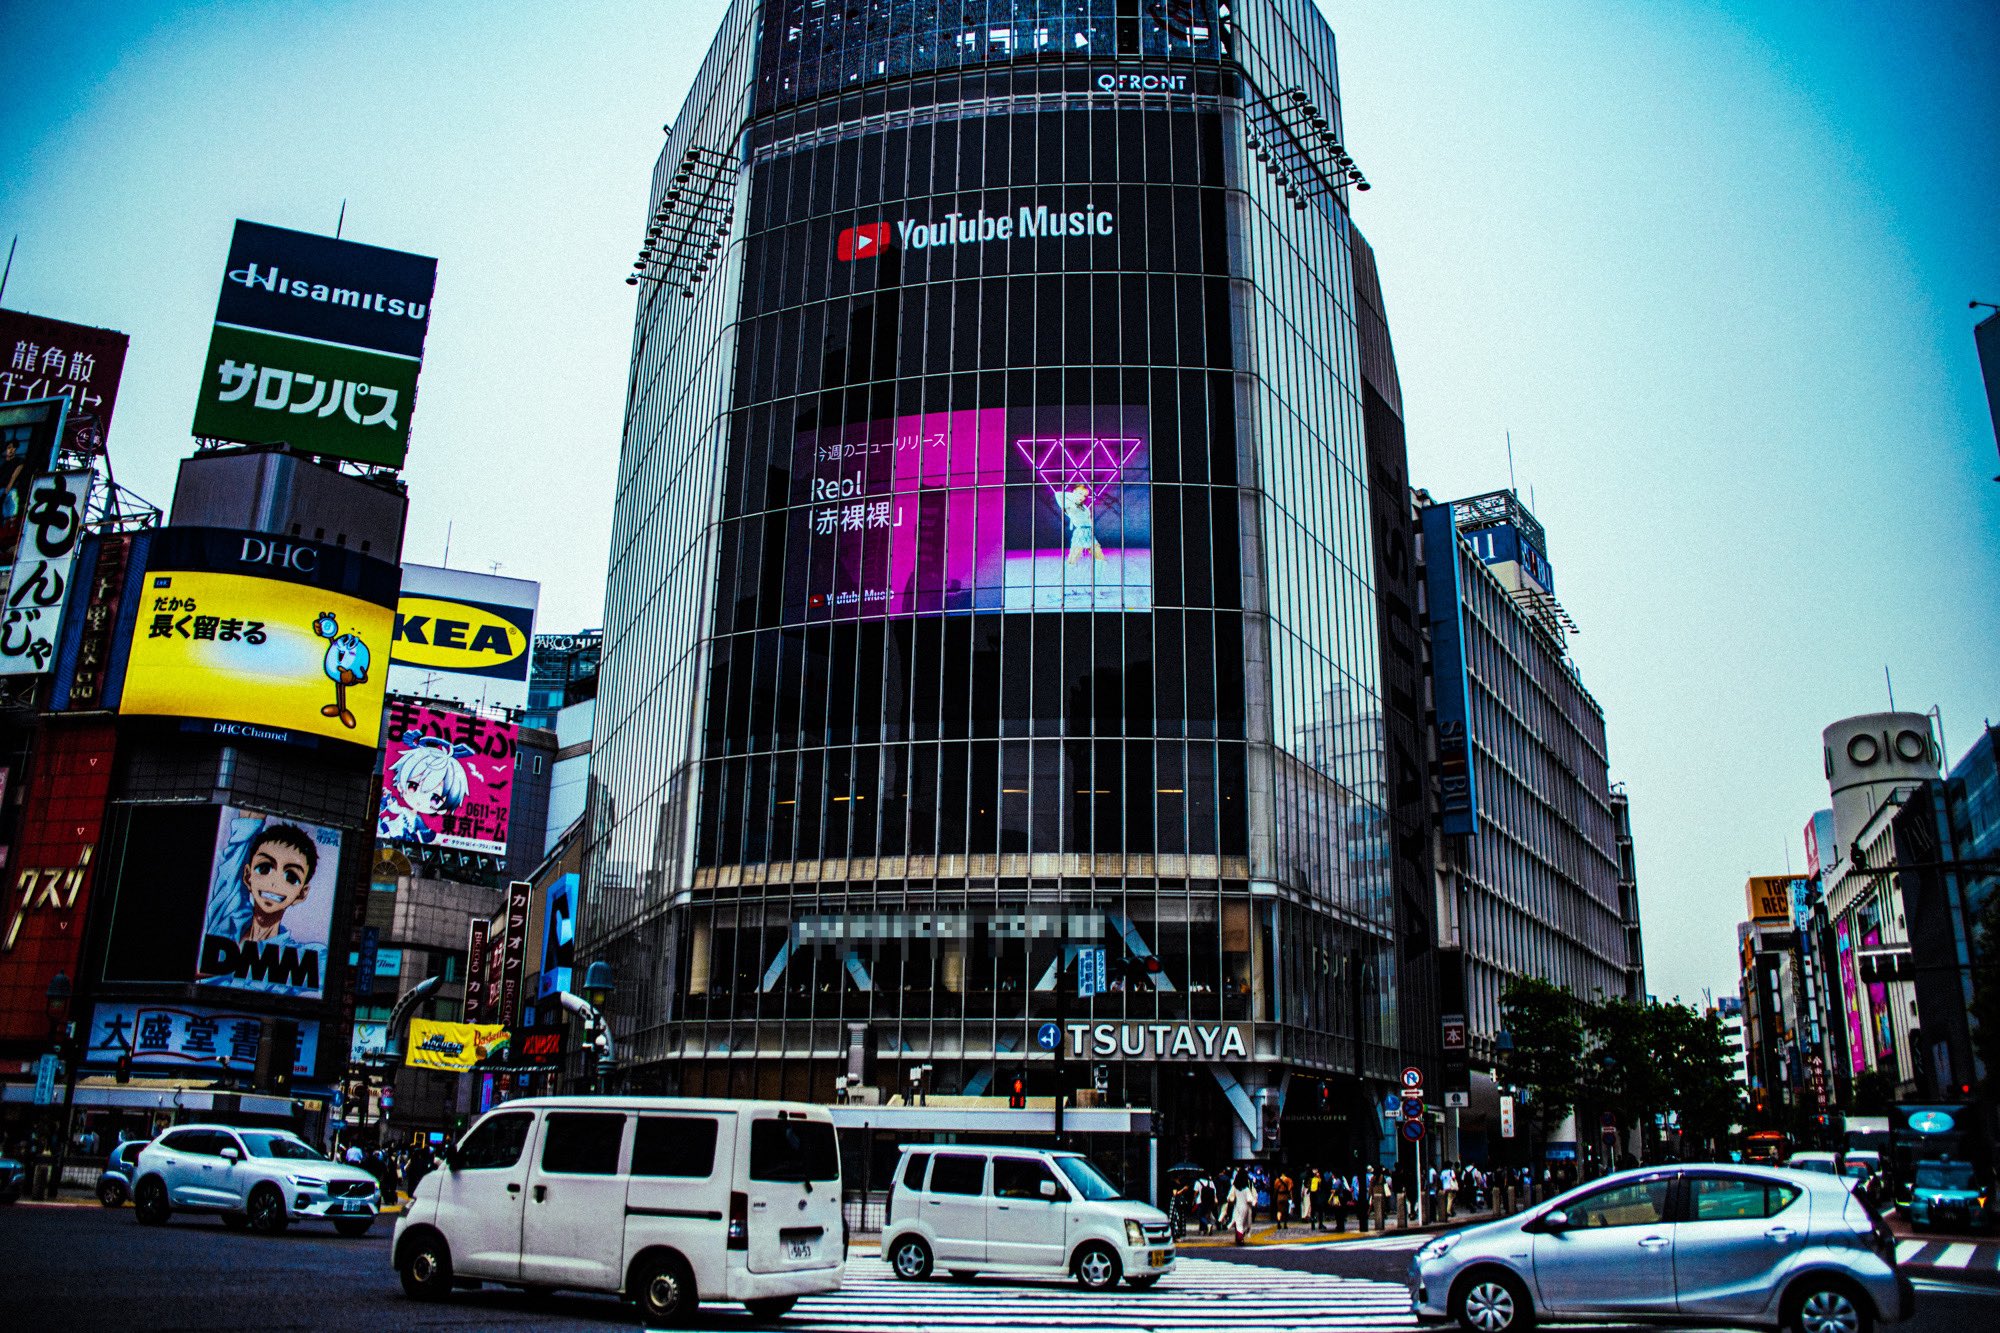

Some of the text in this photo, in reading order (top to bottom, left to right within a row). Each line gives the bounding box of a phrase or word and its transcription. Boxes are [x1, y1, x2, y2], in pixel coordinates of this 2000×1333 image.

[1098, 74, 1187, 93] QFRONT
[897, 203, 1113, 250] YouTube Music
[228, 263, 426, 320] Hisamitsu
[11, 341, 96, 383] 龍角散
[218, 359, 399, 431] サロンパス
[814, 433, 946, 462] 今週のニューリリース
[811, 470, 862, 501] Reol
[808, 502, 903, 535] 「赤裸裸」
[0, 475, 80, 669] もんじゃ
[240, 538, 317, 571] DHC
[153, 597, 196, 612] だから
[149, 615, 266, 645] 長く留まる
[395, 613, 513, 655] KEA
[213, 722, 287, 743] DHC Channel
[388, 701, 517, 760] まふまふ
[442, 815, 505, 843] 東京ドーム
[466, 802, 507, 821] 0611-12
[4, 844, 95, 951] クスリ
[506, 893, 527, 970] カラオケ
[200, 933, 320, 989] DMM
[1312, 945, 1377, 988] TSUTYA
[1067, 1024, 1246, 1057] TSUTAYA
